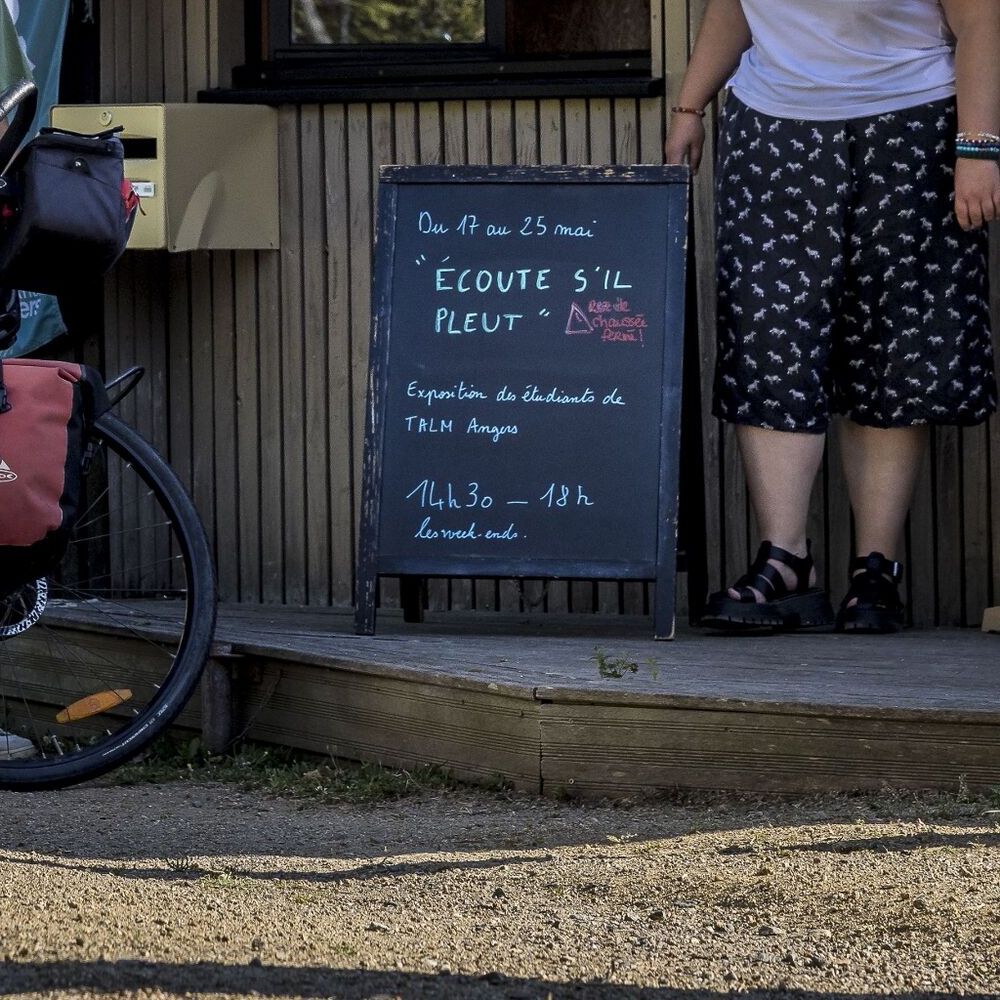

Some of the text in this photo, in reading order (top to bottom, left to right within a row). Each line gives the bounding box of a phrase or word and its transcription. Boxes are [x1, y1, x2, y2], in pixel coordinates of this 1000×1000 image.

[419, 211, 598, 238] Du 17 au 25 mai
[574, 266, 633, 293] S'IL
[407, 380, 626, 406] Exposition des étudiants de
[405, 415, 518, 442] TALM Angers
